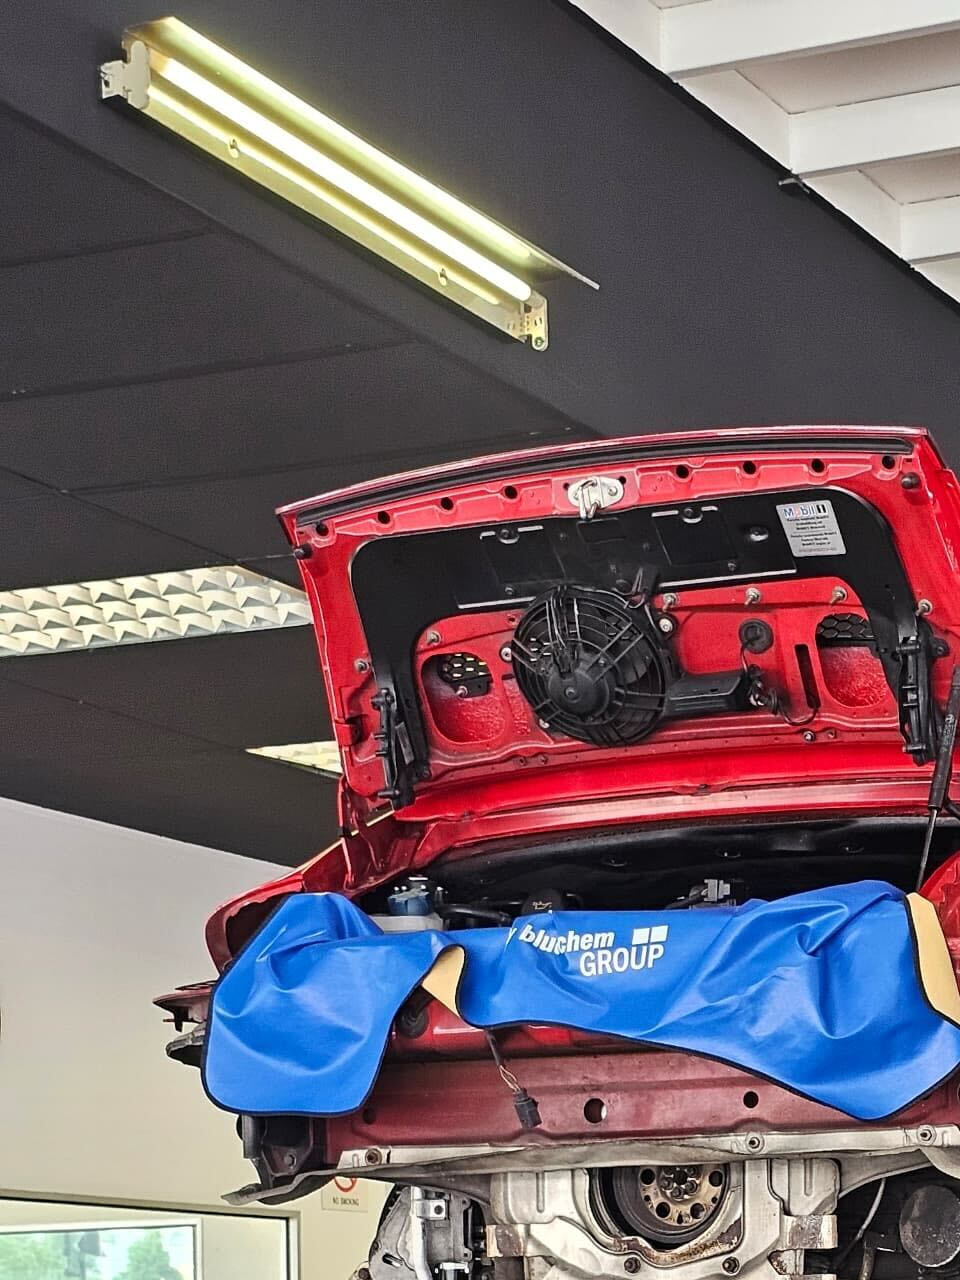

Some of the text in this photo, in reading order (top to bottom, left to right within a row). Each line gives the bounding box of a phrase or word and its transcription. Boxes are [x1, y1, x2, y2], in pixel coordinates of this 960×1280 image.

[783, 504, 815, 517] Mobil
[518, 924, 615, 956] bluchem
[579, 943, 665, 977] GROUP
